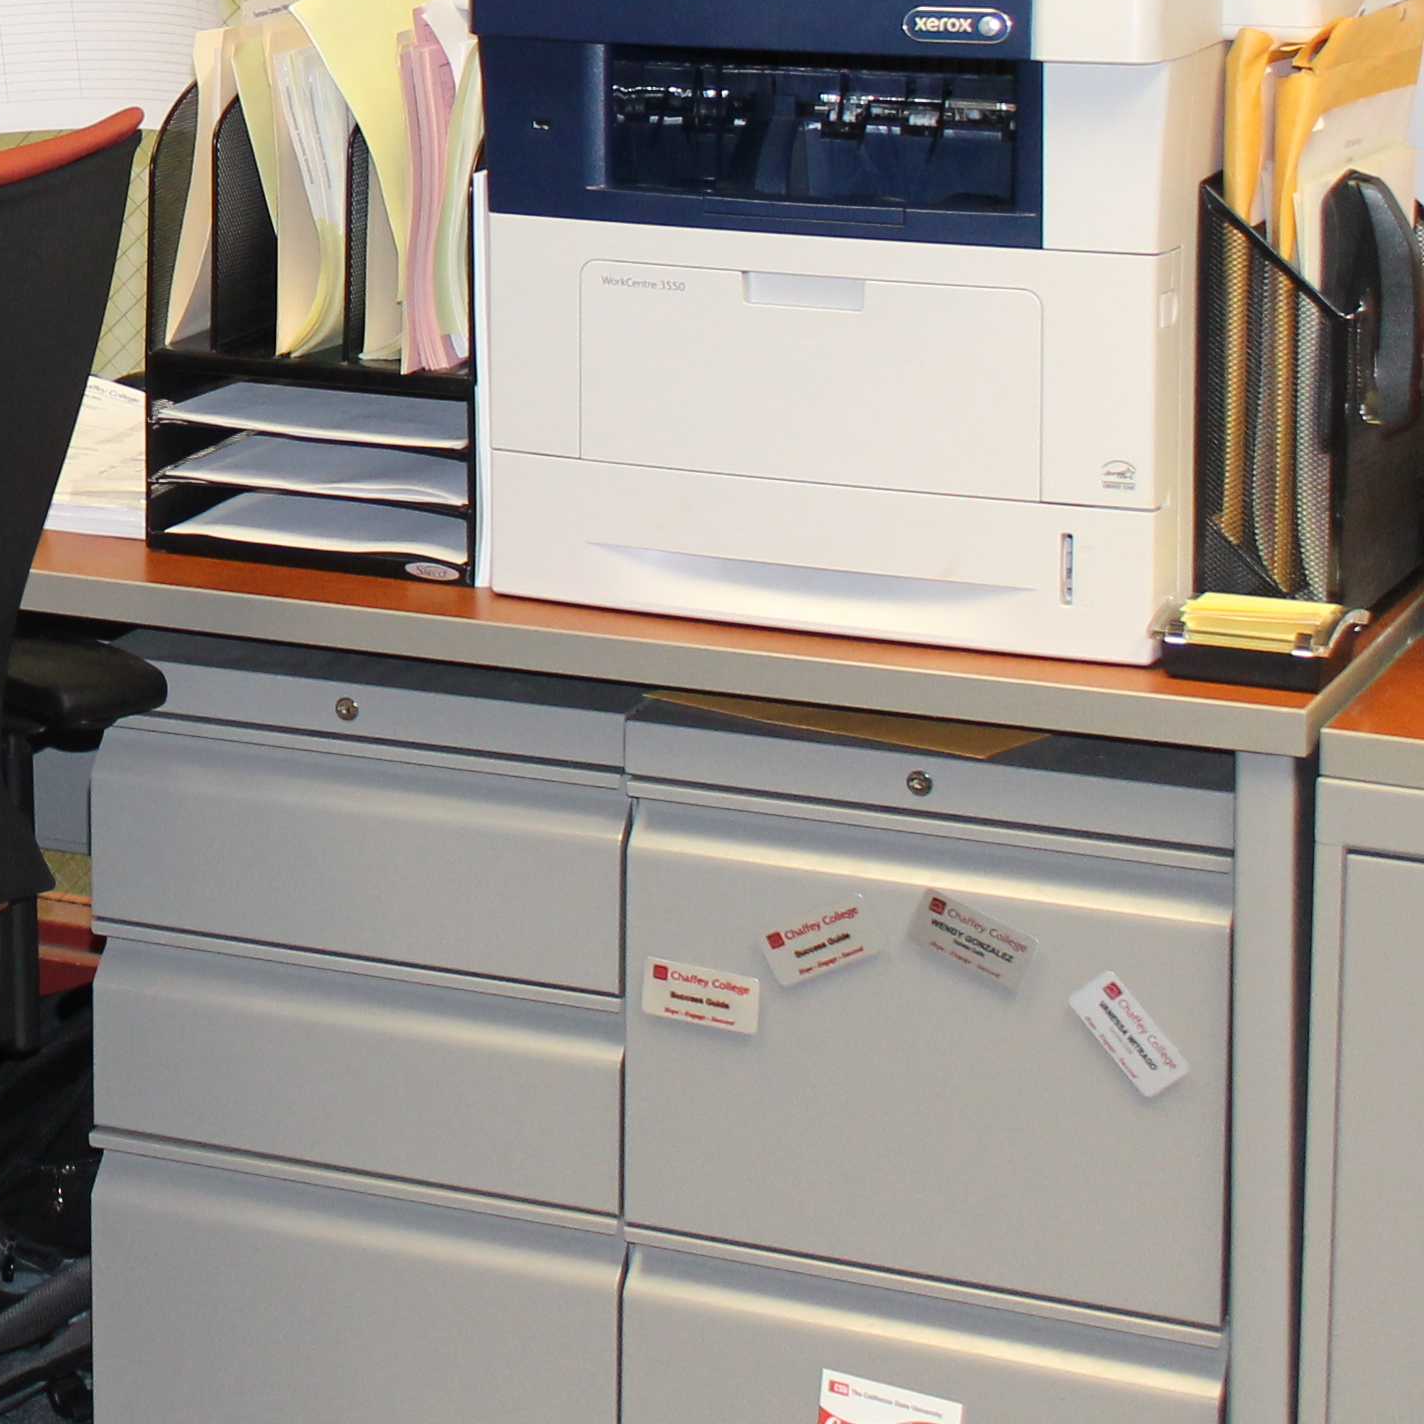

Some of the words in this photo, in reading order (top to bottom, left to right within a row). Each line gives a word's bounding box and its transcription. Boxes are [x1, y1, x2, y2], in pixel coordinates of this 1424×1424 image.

[914, 17, 973, 32] xerox
[601, 276, 657, 289] WorkCentre
[660, 280, 685, 292] 3550
[784, 922, 820, 940] Chaffey
[822, 907, 859, 925] College
[947, 908, 986, 933] Chaffey
[989, 928, 1028, 953] College
[671, 971, 709, 988] Chaffey
[712, 979, 750, 996] College
[1118, 998, 1148, 1034] Chaffey
[1147, 1034, 1177, 1069] College
